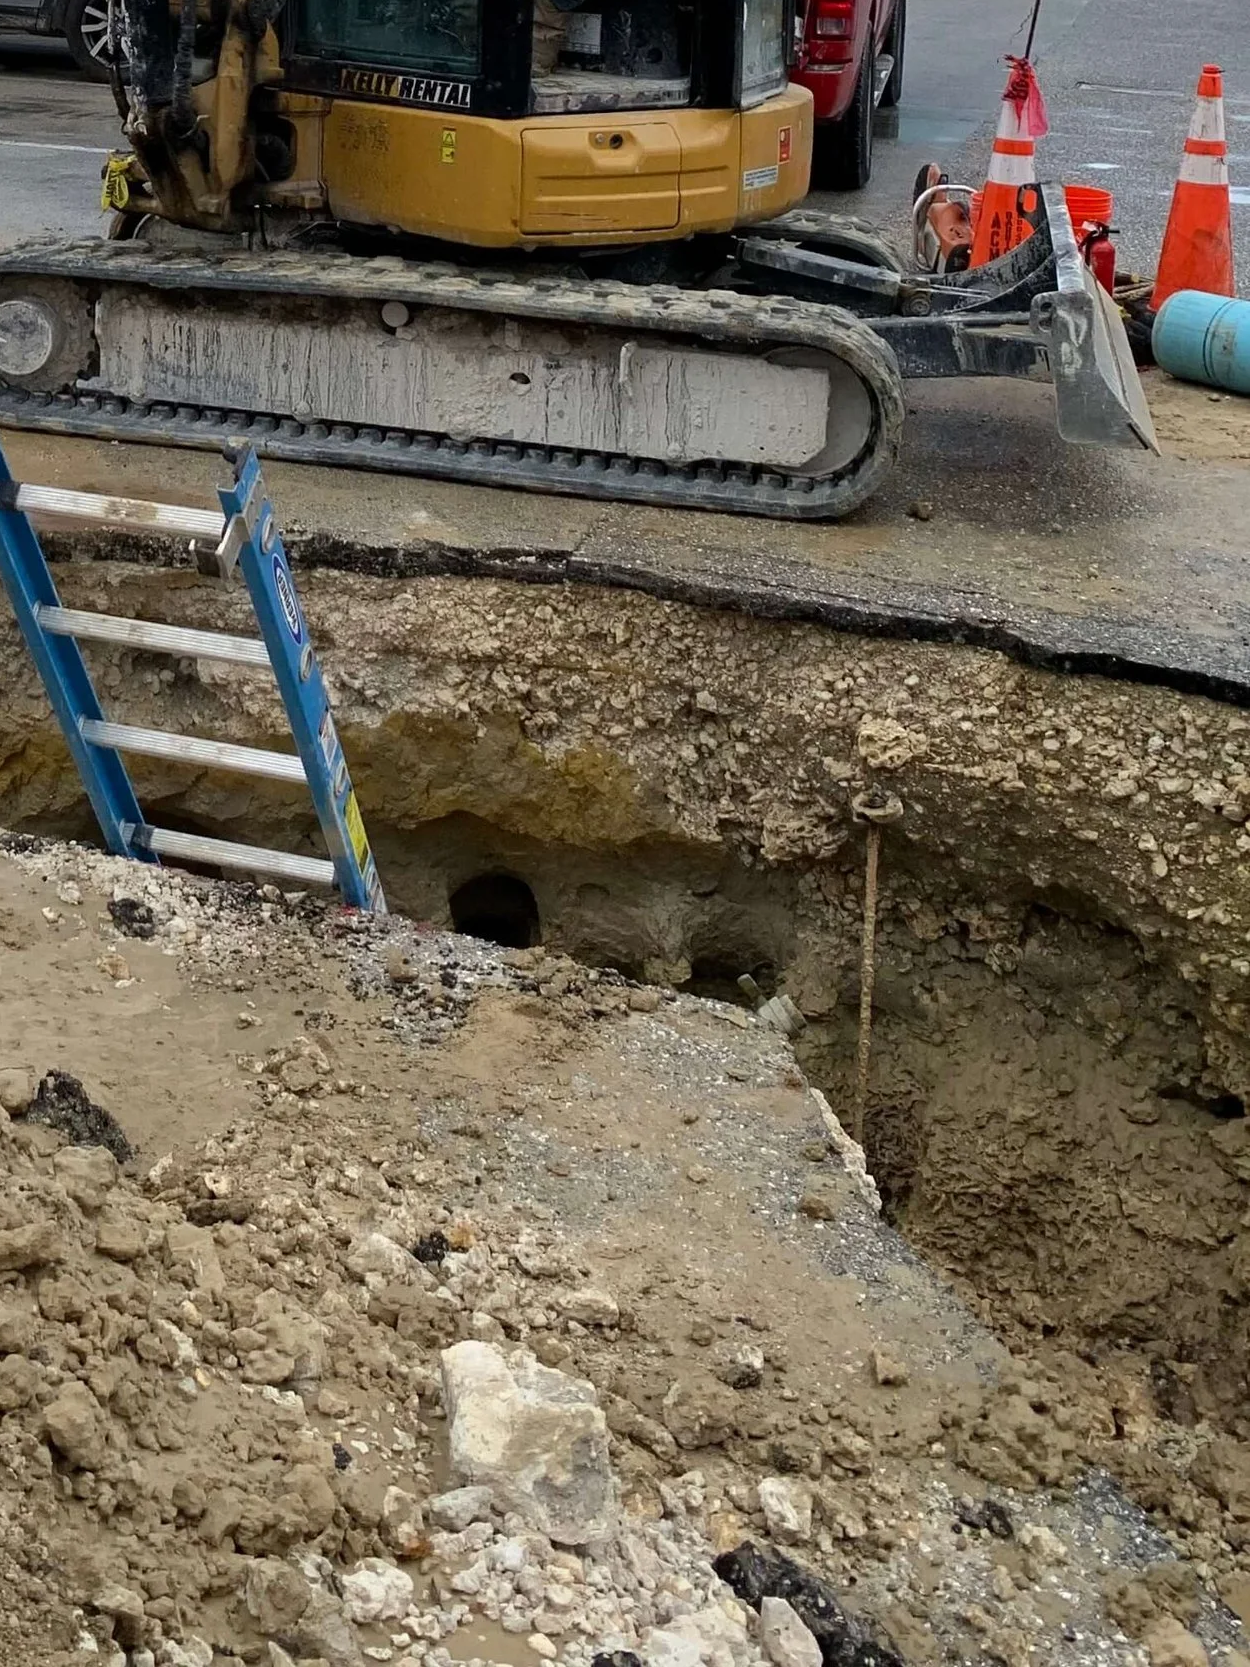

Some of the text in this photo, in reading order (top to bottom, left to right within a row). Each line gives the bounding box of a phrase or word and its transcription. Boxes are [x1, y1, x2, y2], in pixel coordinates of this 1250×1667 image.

[342, 69, 470, 106] KELLY RENTAL
[277, 572, 298, 630] WERNER
